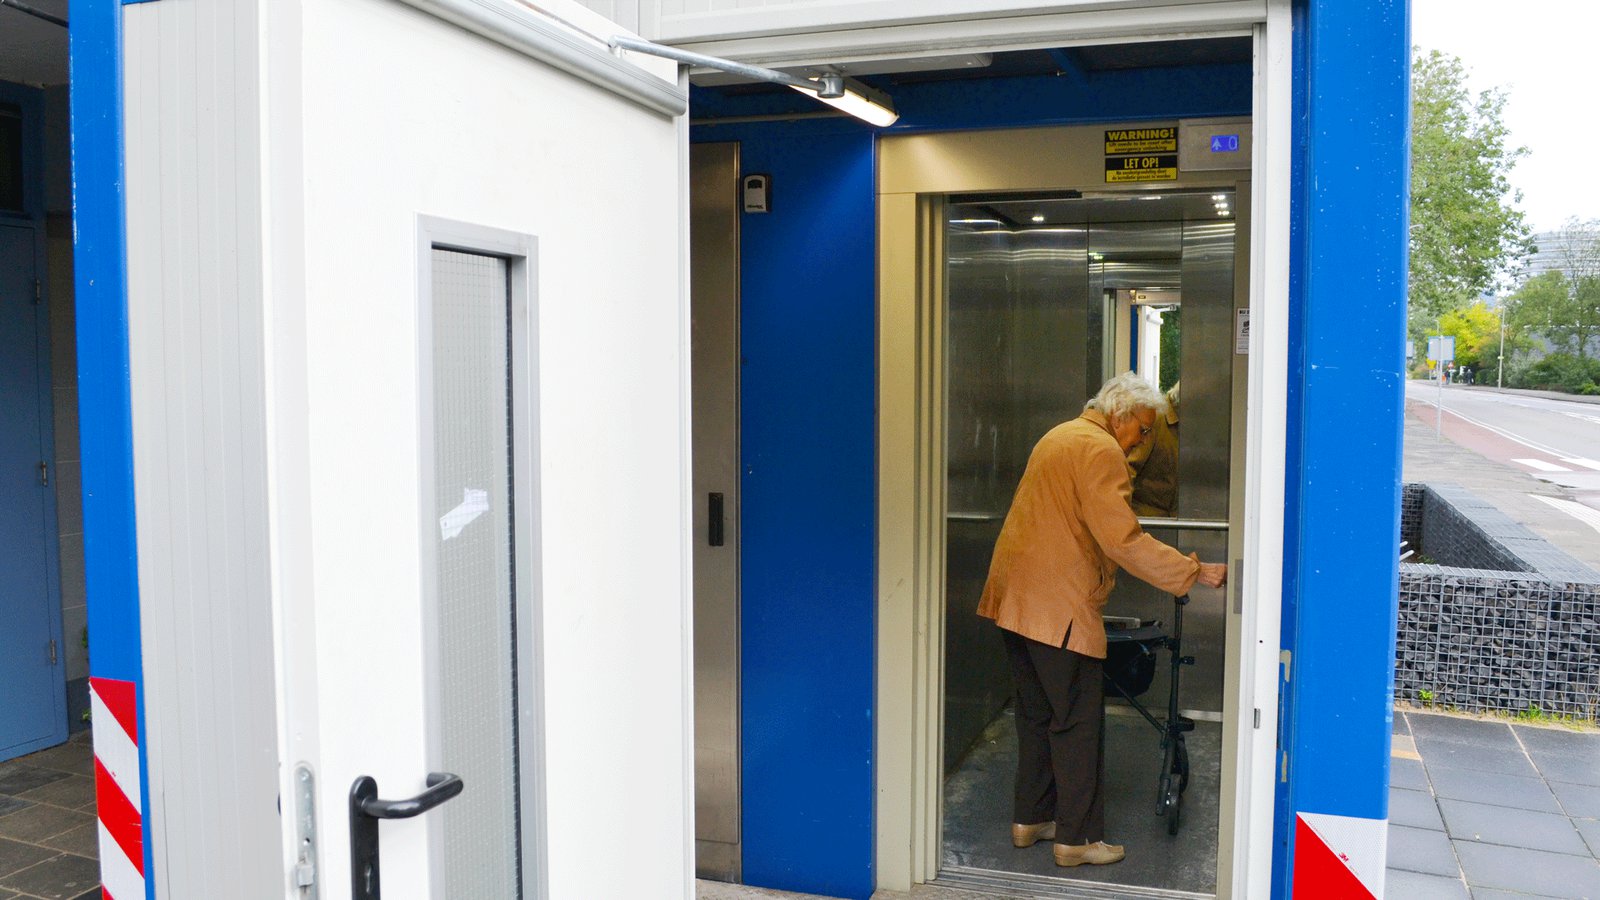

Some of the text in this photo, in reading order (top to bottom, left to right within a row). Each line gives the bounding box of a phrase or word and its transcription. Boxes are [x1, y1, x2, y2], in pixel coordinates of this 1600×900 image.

[1108, 128, 1174, 141] WARNING!
[1228, 136, 1238, 150] 0
[1124, 157, 1159, 169] LET OP!
